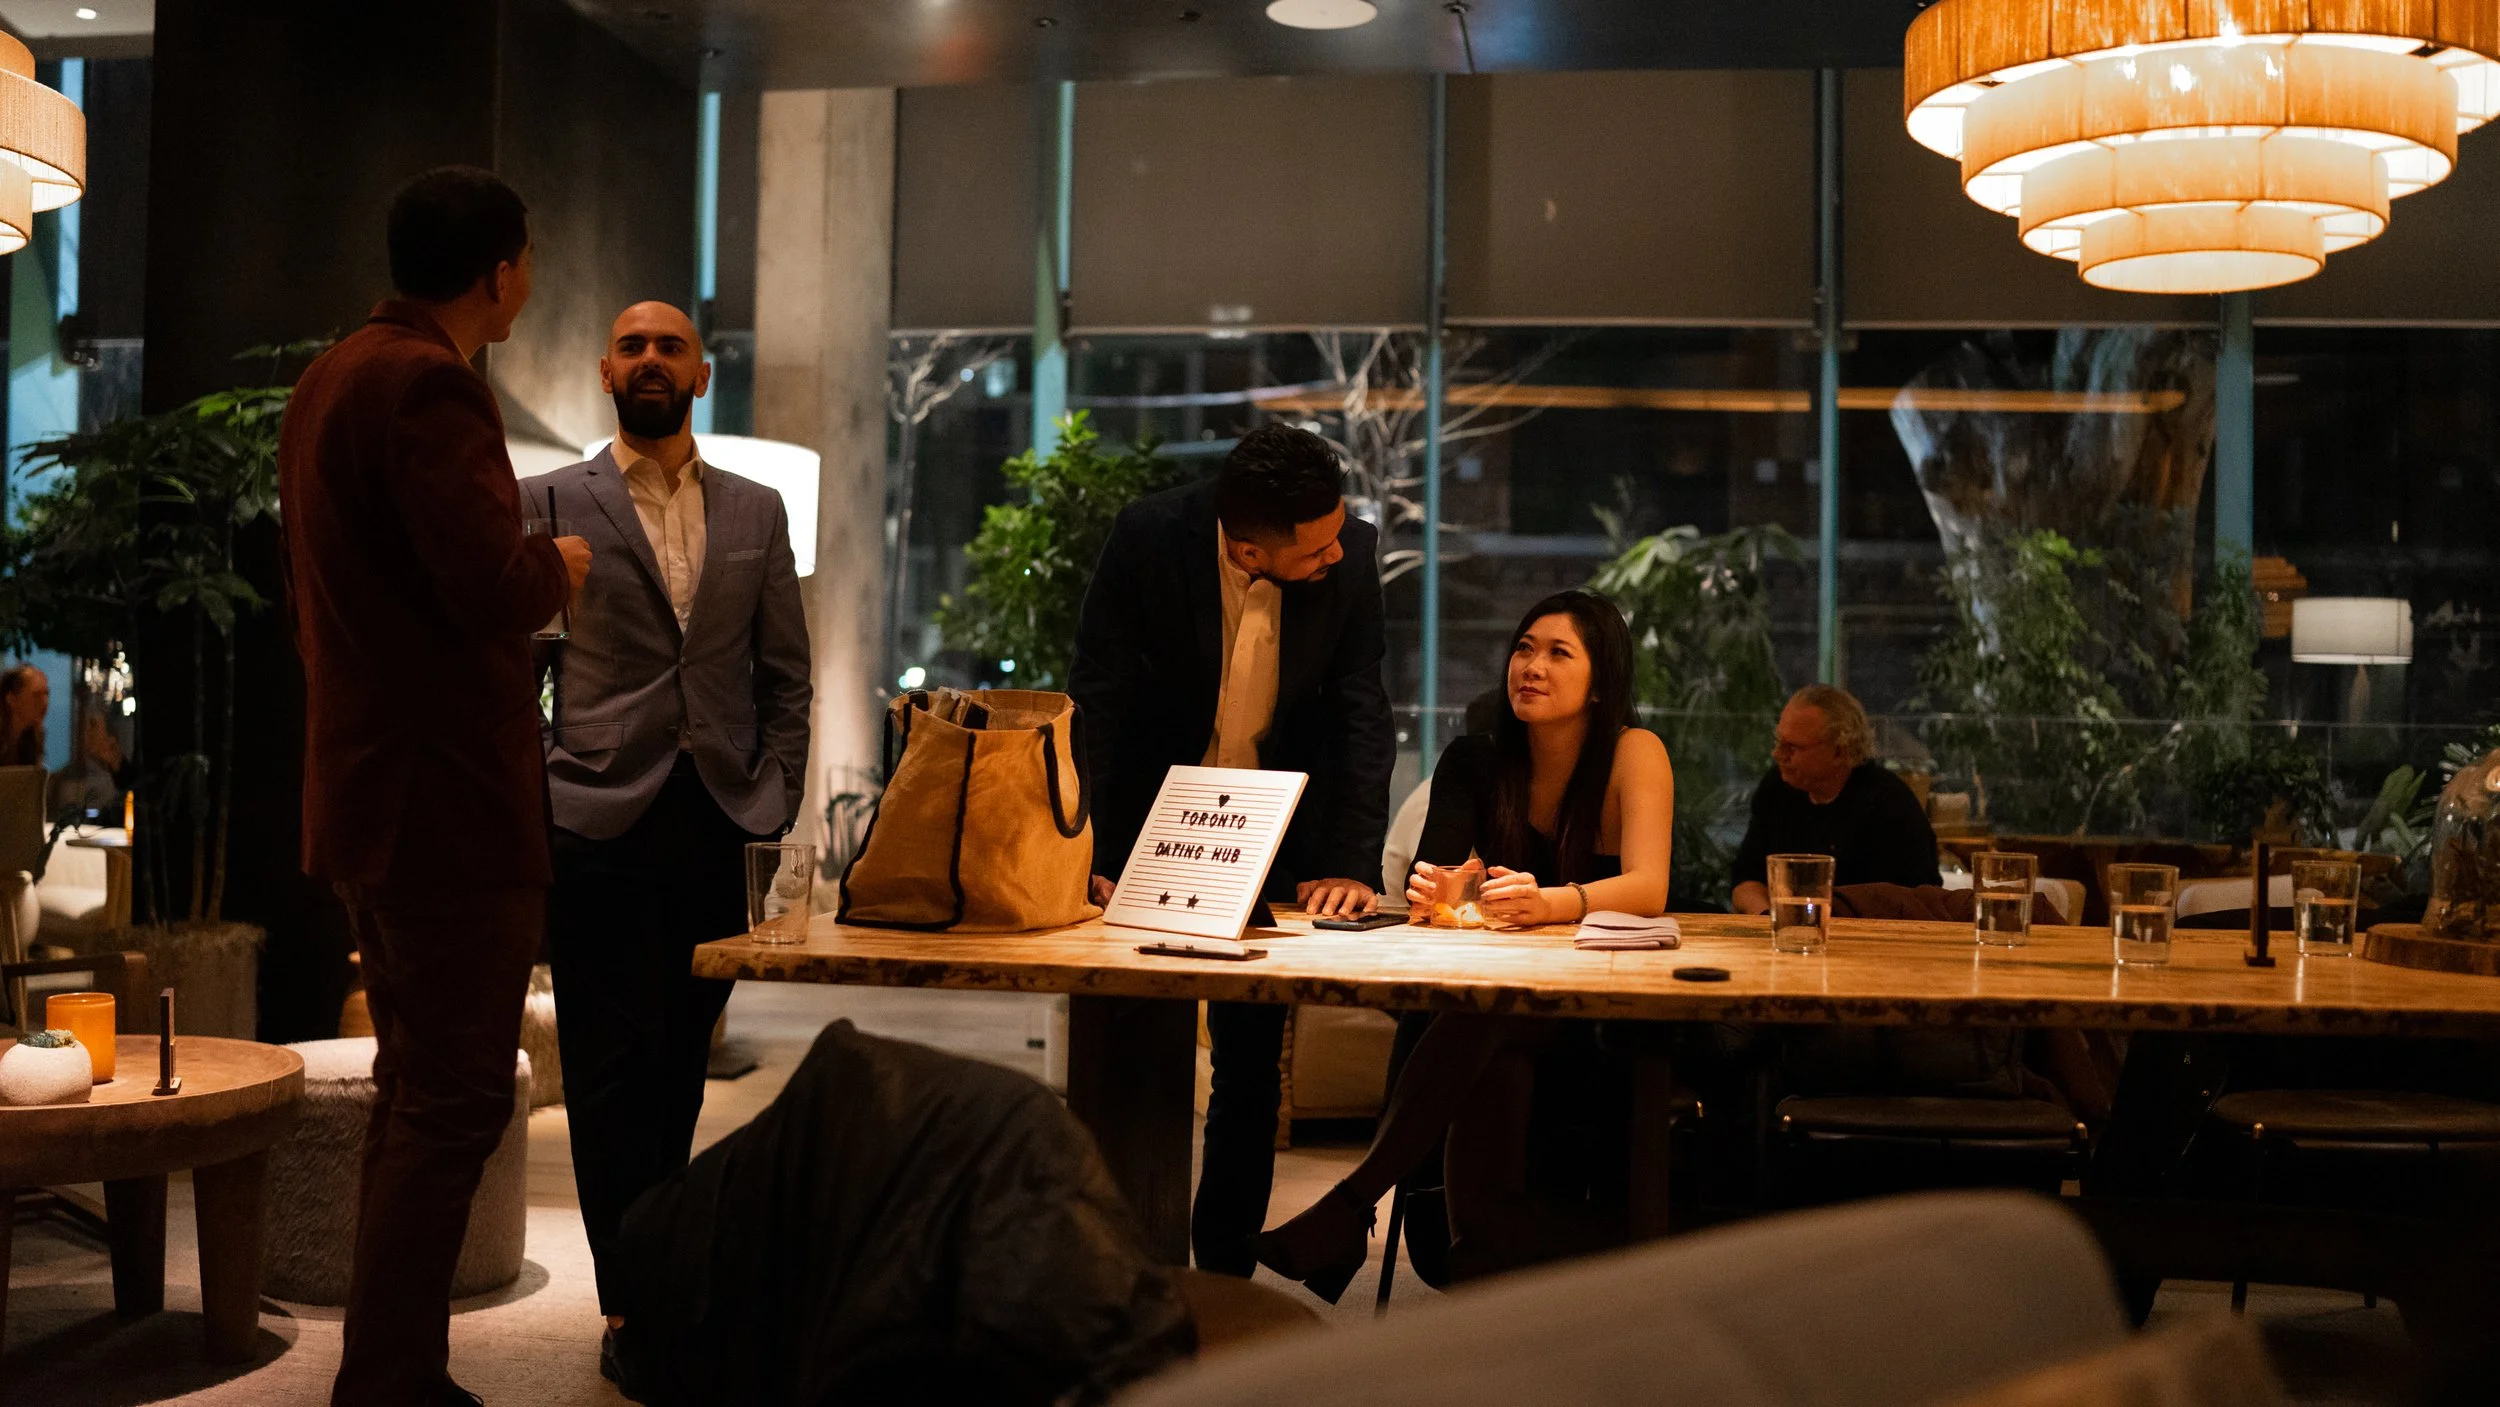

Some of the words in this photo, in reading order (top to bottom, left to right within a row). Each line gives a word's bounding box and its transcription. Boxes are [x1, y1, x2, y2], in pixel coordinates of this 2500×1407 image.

[1180, 810, 1247, 830] TORONTO
[1155, 842, 1204, 860] DATING
[1211, 847, 1241, 863] HUB
